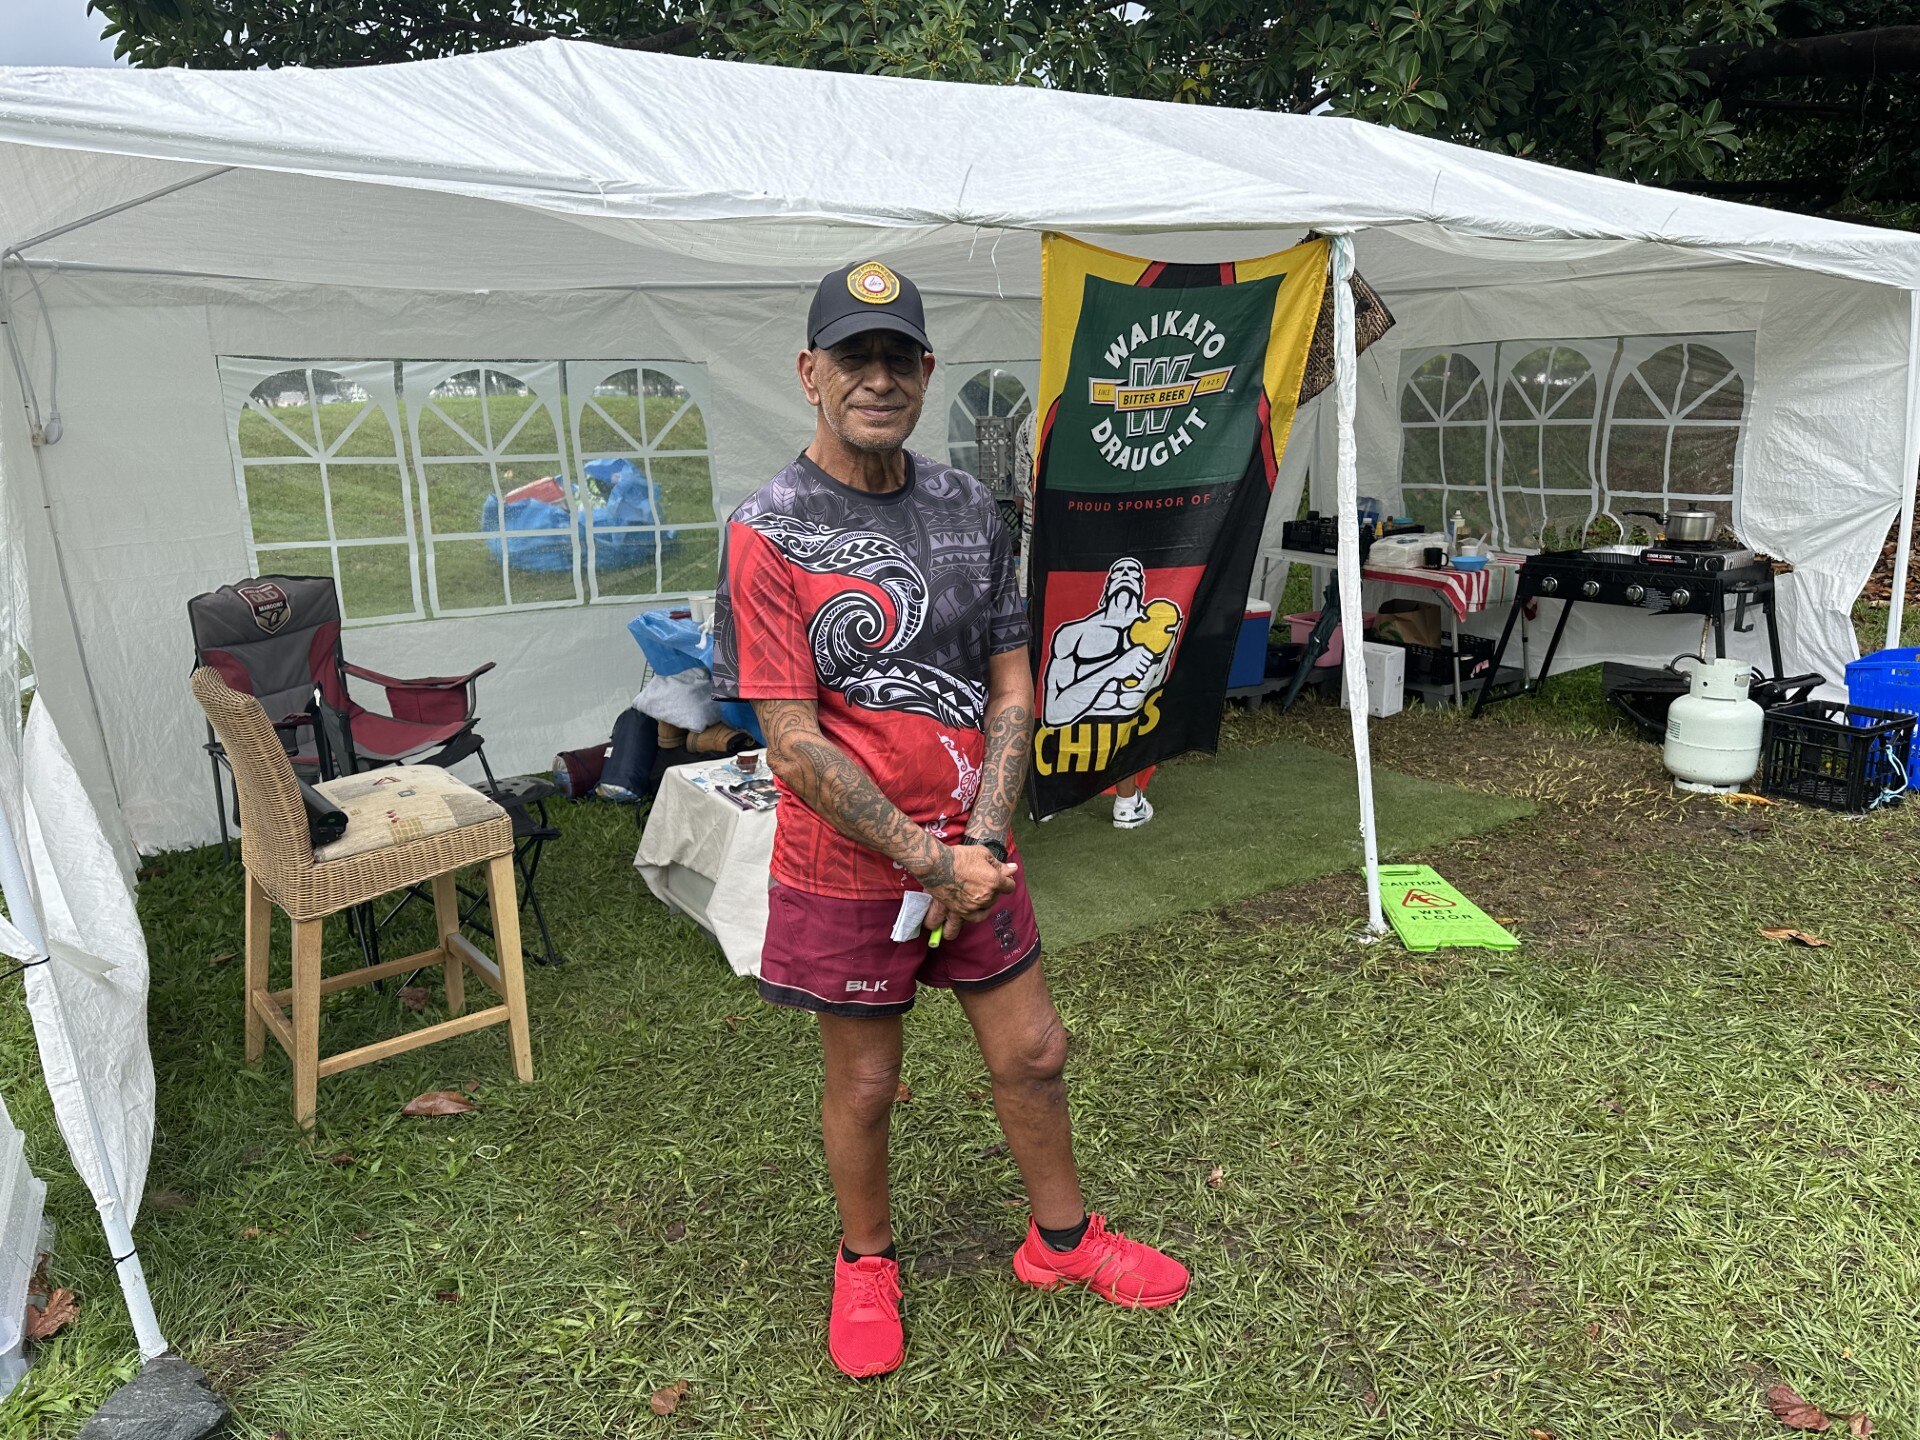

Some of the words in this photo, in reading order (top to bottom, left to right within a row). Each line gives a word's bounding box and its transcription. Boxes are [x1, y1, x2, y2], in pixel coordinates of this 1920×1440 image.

[1104, 310, 1226, 369] WAIKATO
[1122, 393, 1155, 406] BITTER
[1158, 389, 1186, 403] BEER
[1090, 406, 1208, 472] DRAUGHT
[1067, 500, 1111, 512] PROUD
[1117, 496, 1185, 511] SPONSOR
[1191, 493, 1211, 505] OF
[845, 979, 889, 993] BLK
